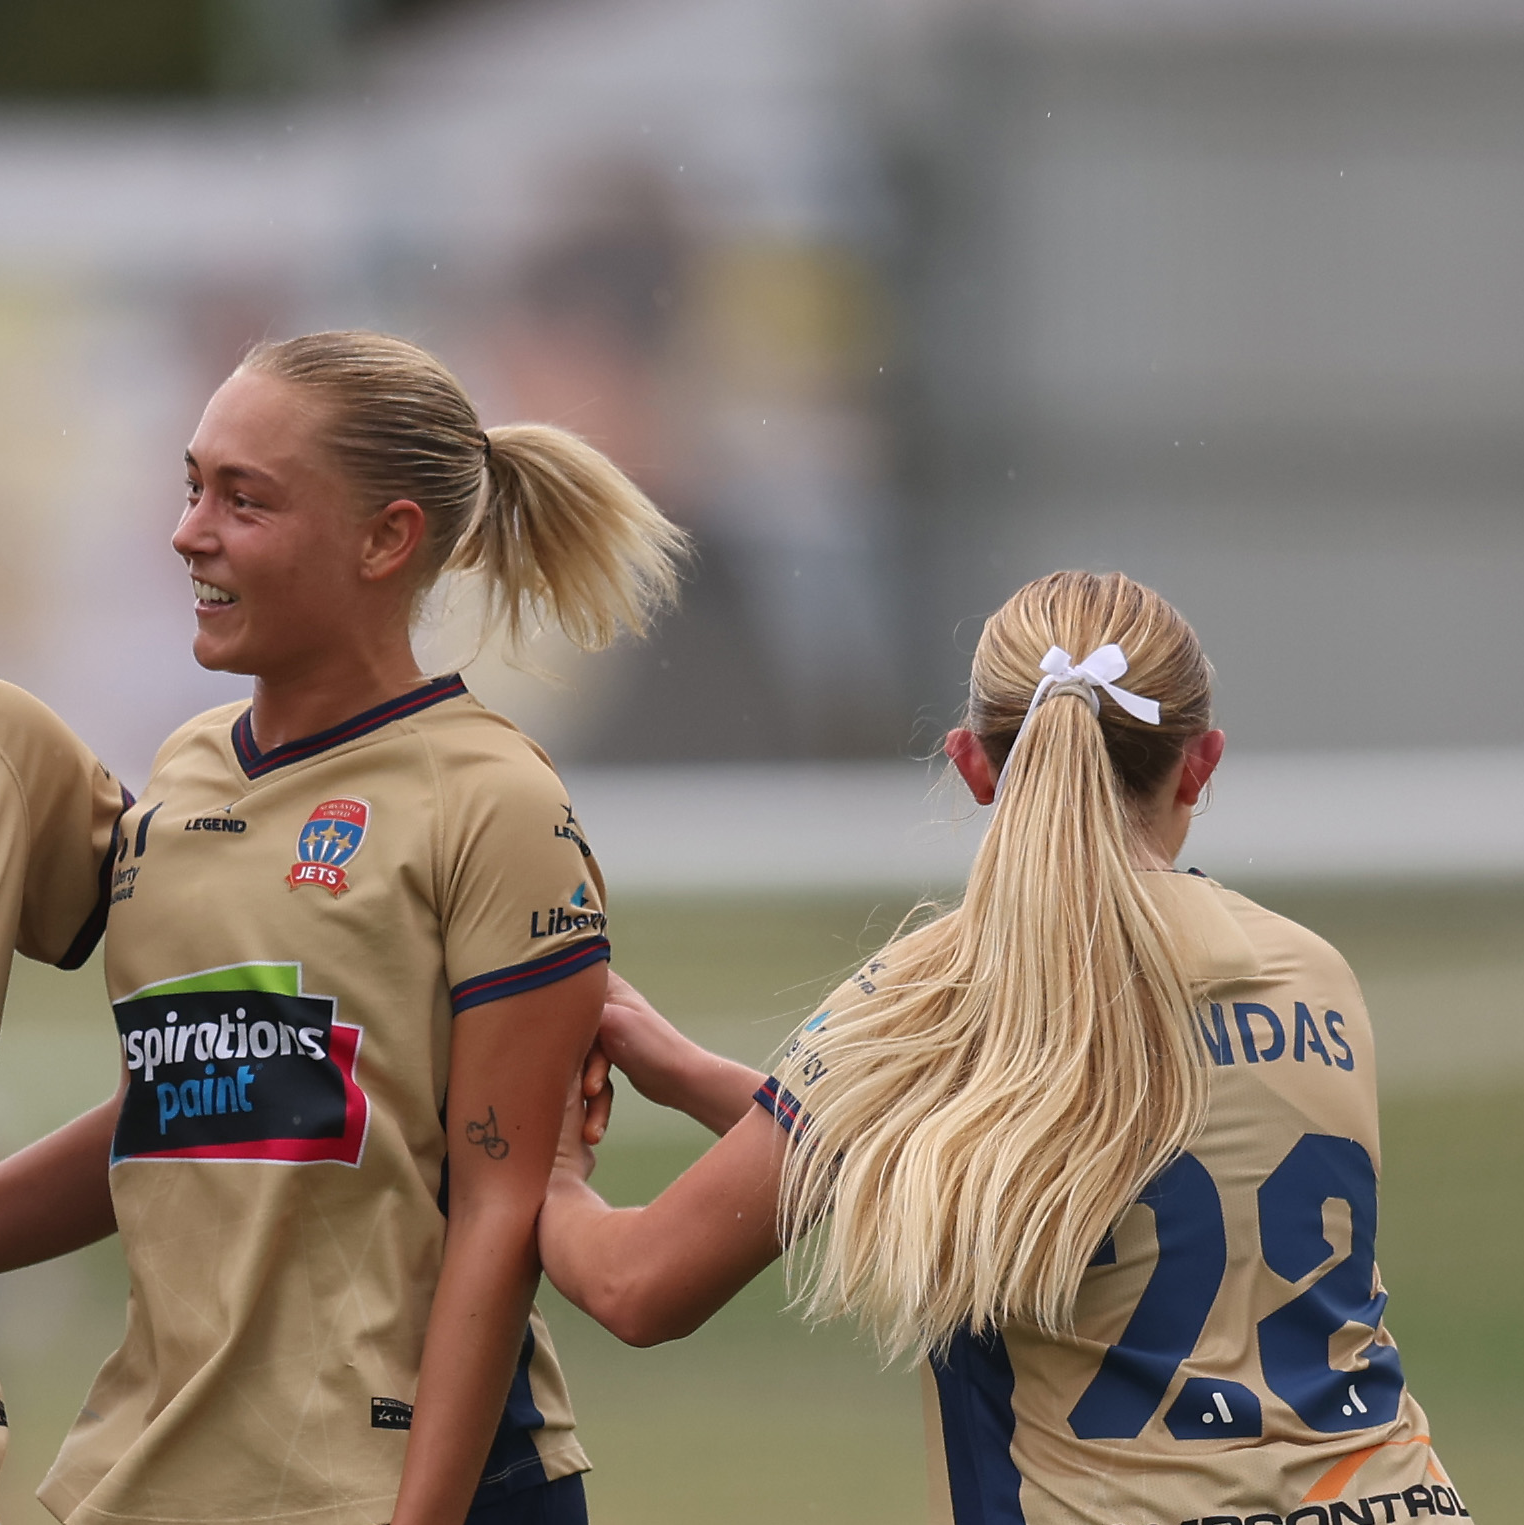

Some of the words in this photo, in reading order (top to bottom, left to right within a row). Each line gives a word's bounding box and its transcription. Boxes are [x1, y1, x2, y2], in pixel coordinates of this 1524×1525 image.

[184, 818, 248, 834] LEGEND
[295, 866, 338, 885] JETS
[121, 1007, 327, 1083] spirations
[1190, 1001, 1355, 1072] NDAS
[156, 1062, 256, 1136] paint
[1067, 1132, 1405, 1440] 28
